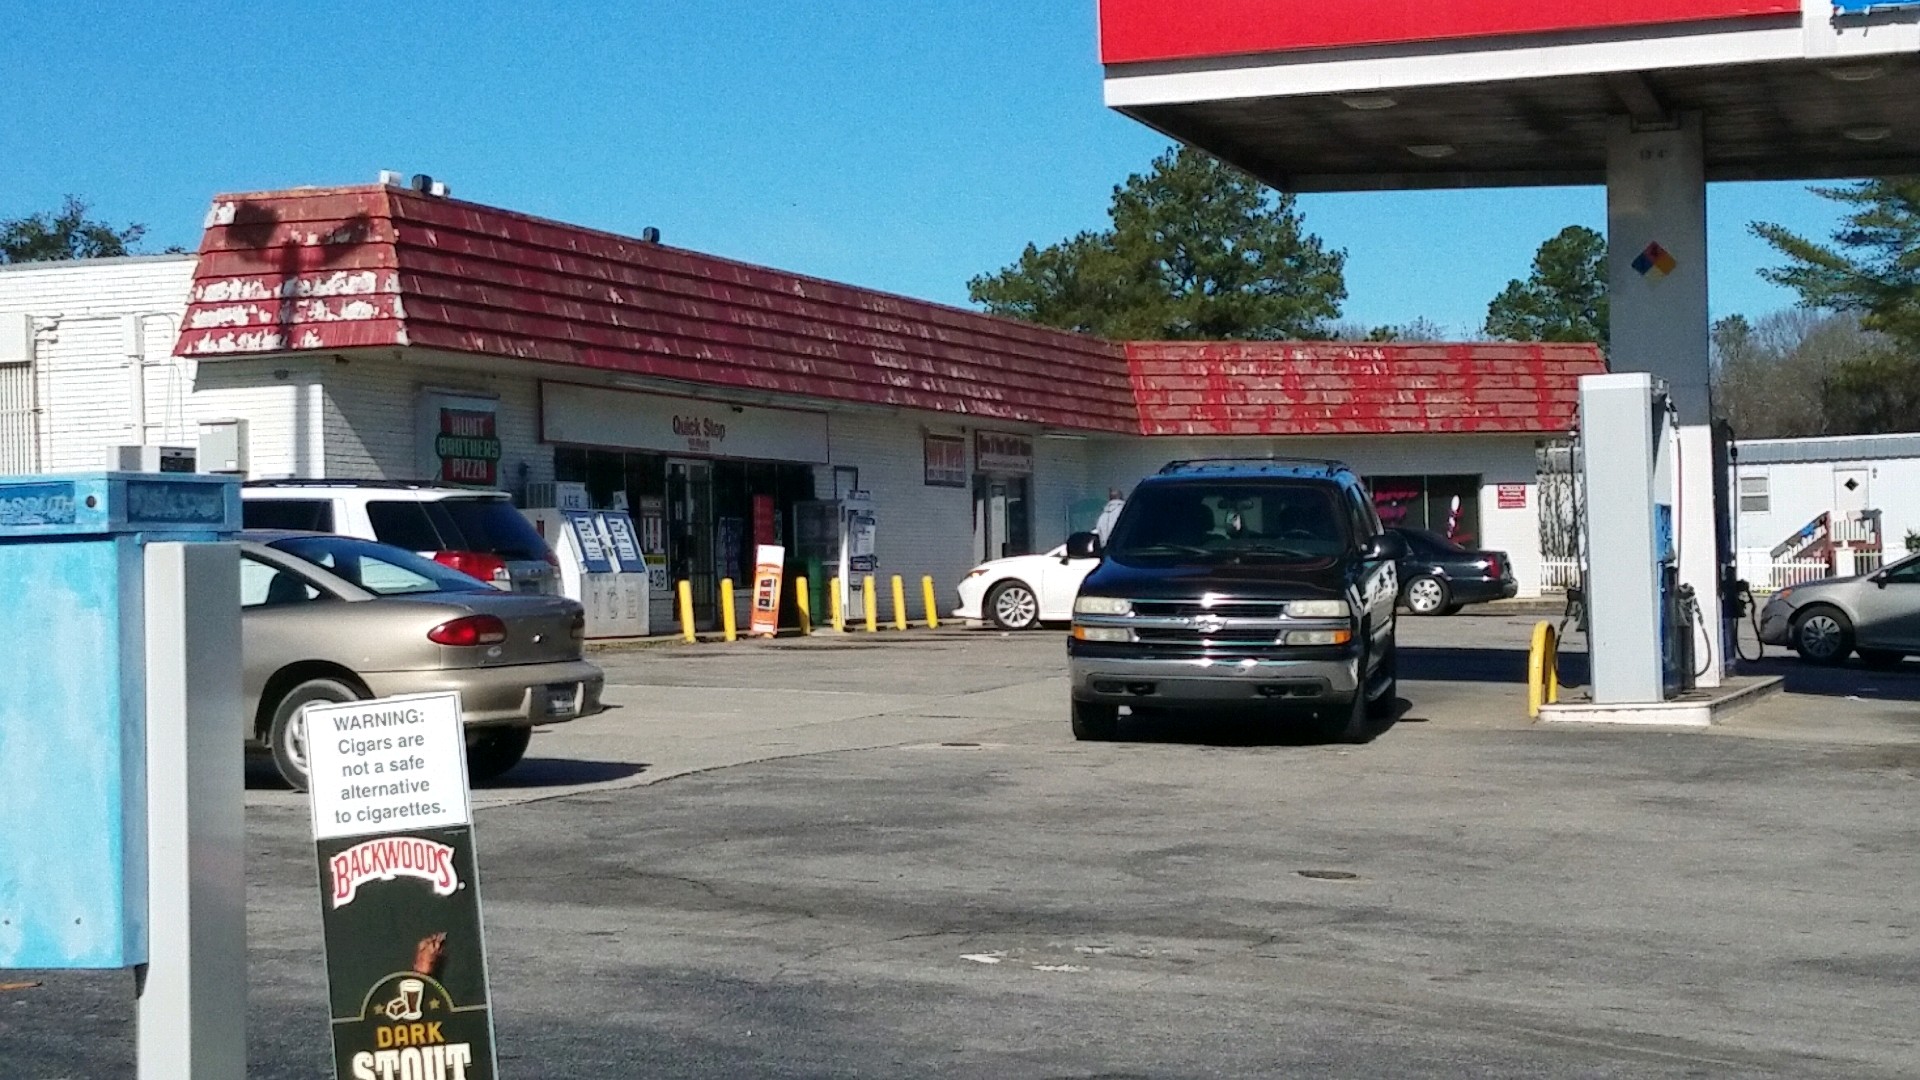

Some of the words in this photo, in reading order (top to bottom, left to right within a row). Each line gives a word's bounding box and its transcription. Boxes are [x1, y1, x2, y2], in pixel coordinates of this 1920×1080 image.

[451, 415, 485, 437] HUNT
[672, 414, 701, 437] Quick
[704, 417, 726, 442] Stop
[438, 436, 500, 458] BROTHERS
[452, 458, 488, 479] PIZZA
[333, 708, 426, 731] WARNING:
[338, 737, 393, 756] Cigars
[397, 734, 425, 748] are
[342, 760, 370, 777] not
[374, 762, 385, 774] a
[389, 755, 425, 772] safe
[341, 778, 431, 800] alternative
[335, 809, 352, 824] to
[356, 802, 447, 824] cigarettes.
[331, 837, 459, 908] BACKWOODS
[376, 1021, 446, 1048] DARK
[352, 1043, 473, 1080] STOUT
